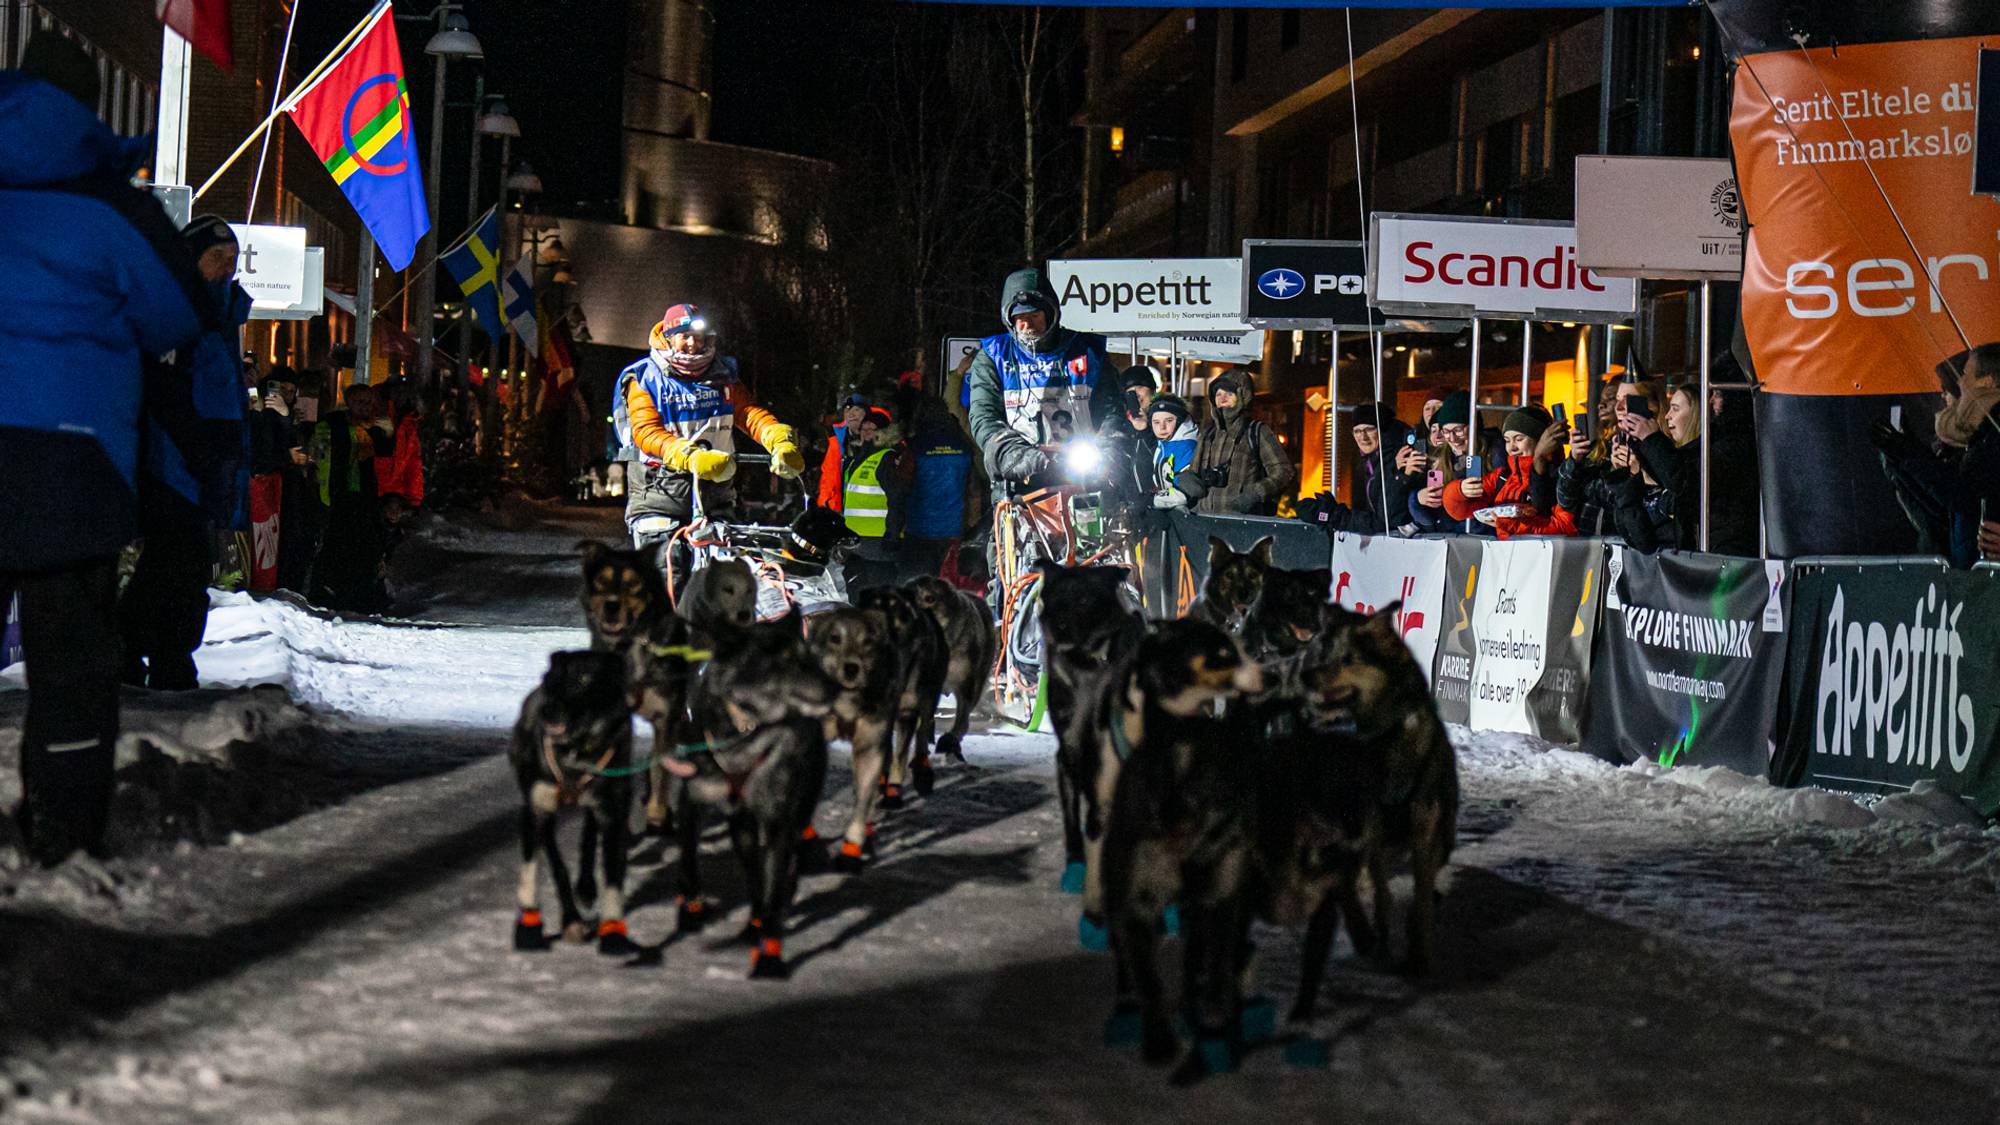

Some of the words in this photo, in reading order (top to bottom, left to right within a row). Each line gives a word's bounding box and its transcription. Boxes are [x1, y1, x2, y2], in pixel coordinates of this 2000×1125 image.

[1772, 92, 1833, 124] Serit
[1840, 87, 1931, 119] Eltele
[1710, 179, 1736, 204] UNIVER
[1702, 243, 1719, 255] UiT
[1404, 241, 1606, 292] Scandic
[1061, 271, 1212, 313] Appetitt
[1314, 274, 1368, 294] PO
[1172, 312, 1180, 320] by
[1182, 312, 1220, 320] Norwegian
[1682, 614, 1755, 658] FINNMARK
[1816, 582, 1975, 774] Appetitt
[1496, 684, 1515, 704] over
